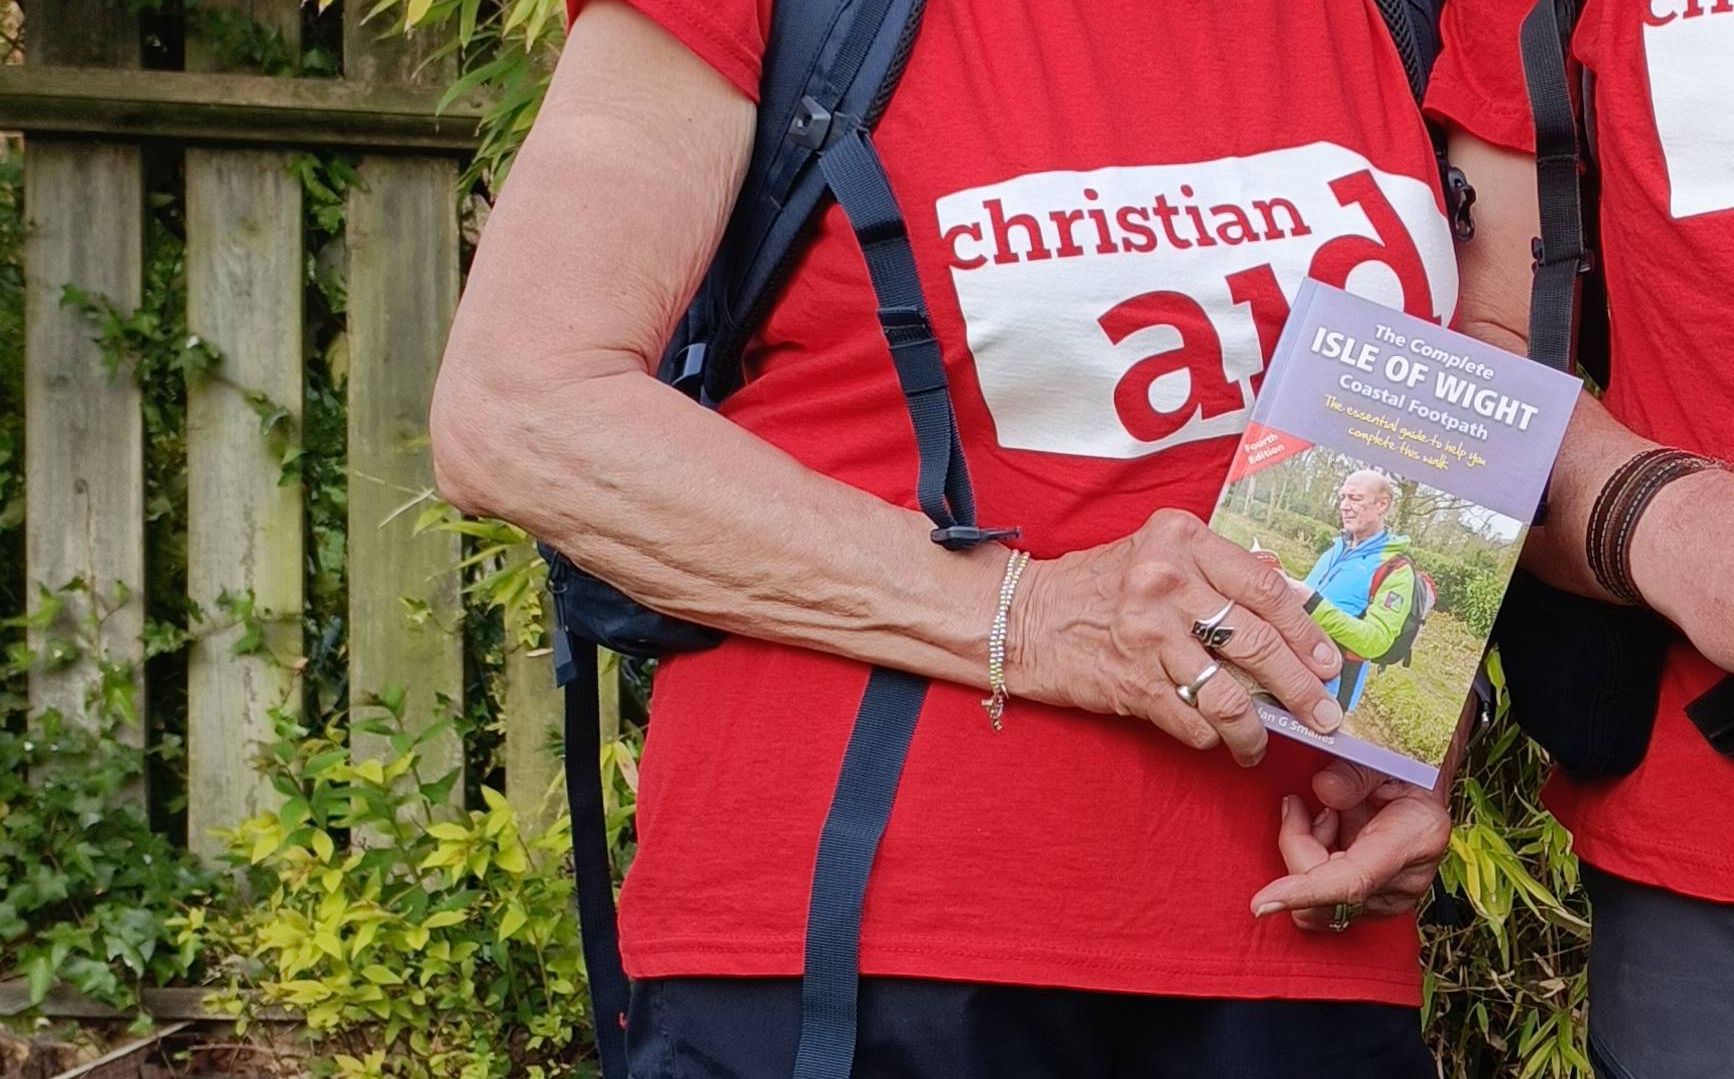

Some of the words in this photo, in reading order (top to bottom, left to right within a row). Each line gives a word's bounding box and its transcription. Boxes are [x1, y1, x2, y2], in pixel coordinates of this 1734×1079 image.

[940, 185, 1311, 271] christian
[1098, 169, 1443, 443] aid
[1311, 327, 1380, 372] ISLE
[1385, 355, 1430, 388] OF
[1434, 371, 1540, 432] WIGHT
[1375, 324, 1406, 347] The
[1411, 338, 1494, 380] Complete
[1324, 394, 1345, 412] The
[1346, 405, 1400, 433] essential
[1399, 427, 1428, 442] guide
[1429, 433, 1443, 448] to
[1445, 441, 1467, 462] help
[1466, 451, 1487, 468] you
[1339, 374, 1406, 409] Coastal
[1408, 399, 1488, 441] Footpath
[1243, 432, 1280, 454] Fourth
[1248, 443, 1286, 465] Edition
[1348, 427, 1397, 451] complete
[1399, 441, 1421, 460] this
[1422, 453, 1449, 471] walk
[1278, 716, 1289, 727] G
